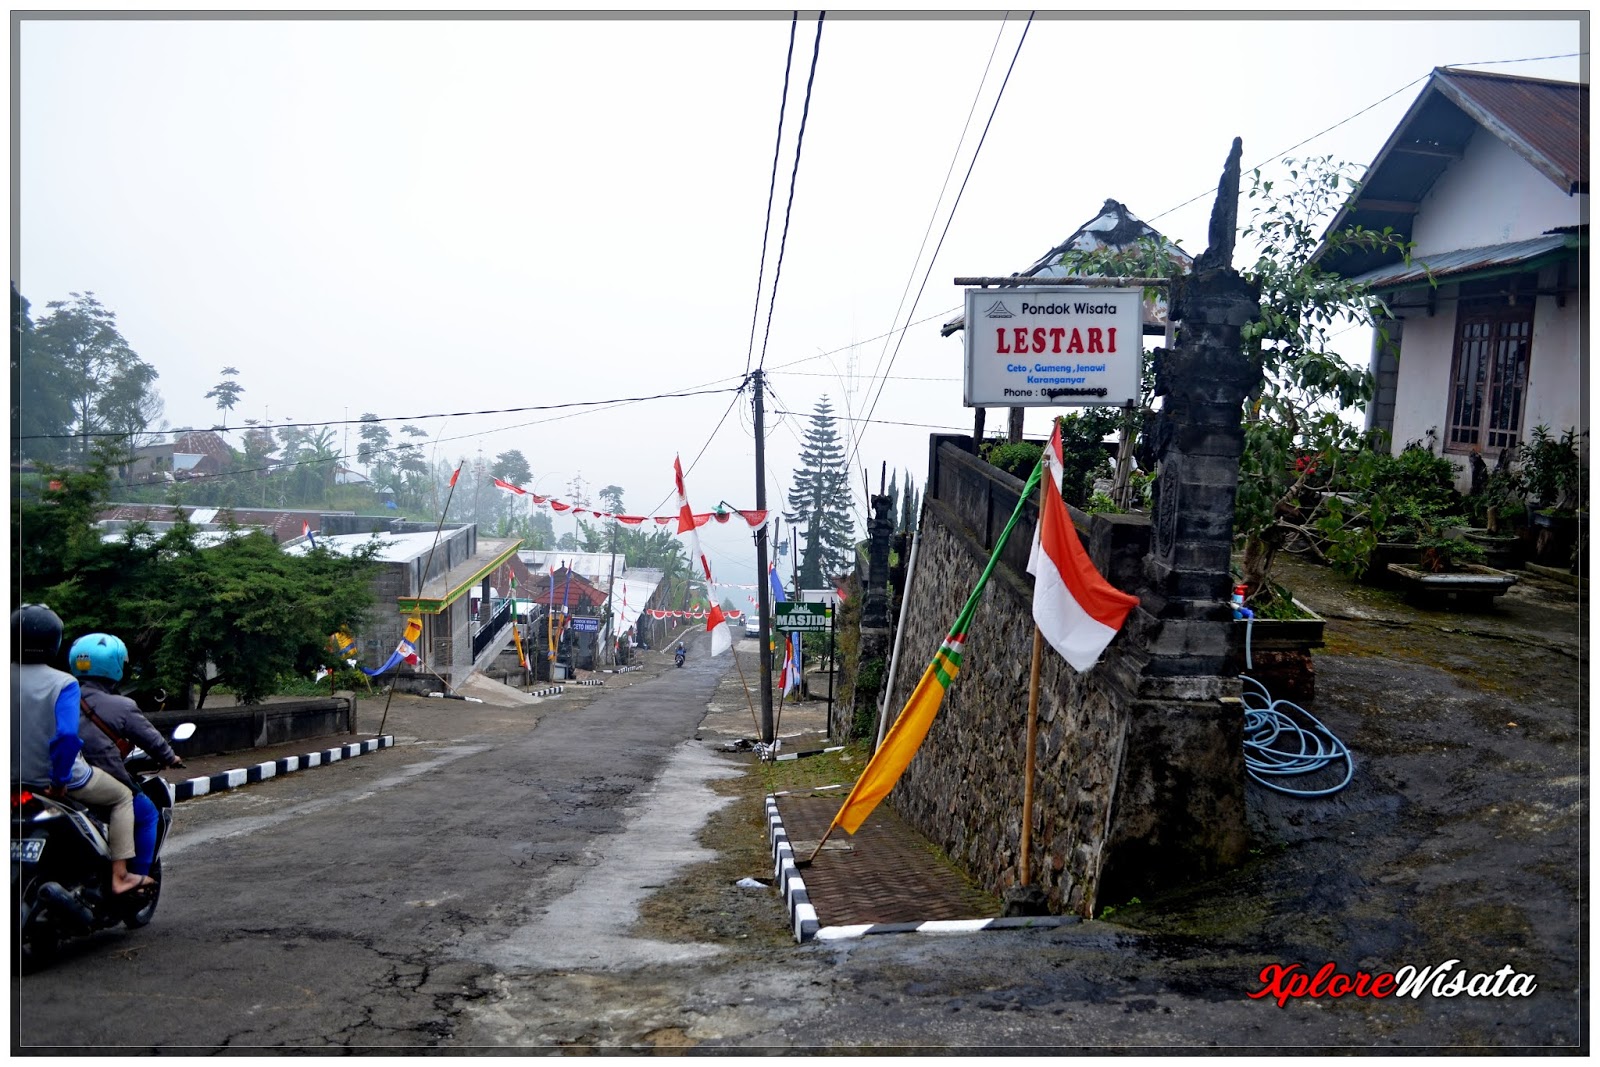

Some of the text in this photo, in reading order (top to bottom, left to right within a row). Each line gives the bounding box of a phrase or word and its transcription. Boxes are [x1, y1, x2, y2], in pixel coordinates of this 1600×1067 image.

[1021, 302, 1117, 315] Pondok Wisata
[996, 327, 1117, 354] LESTARI
[1027, 375, 1086, 385] Karanganyar
[1004, 388, 1033, 397] Phone
[776, 614, 826, 626] MASJID
